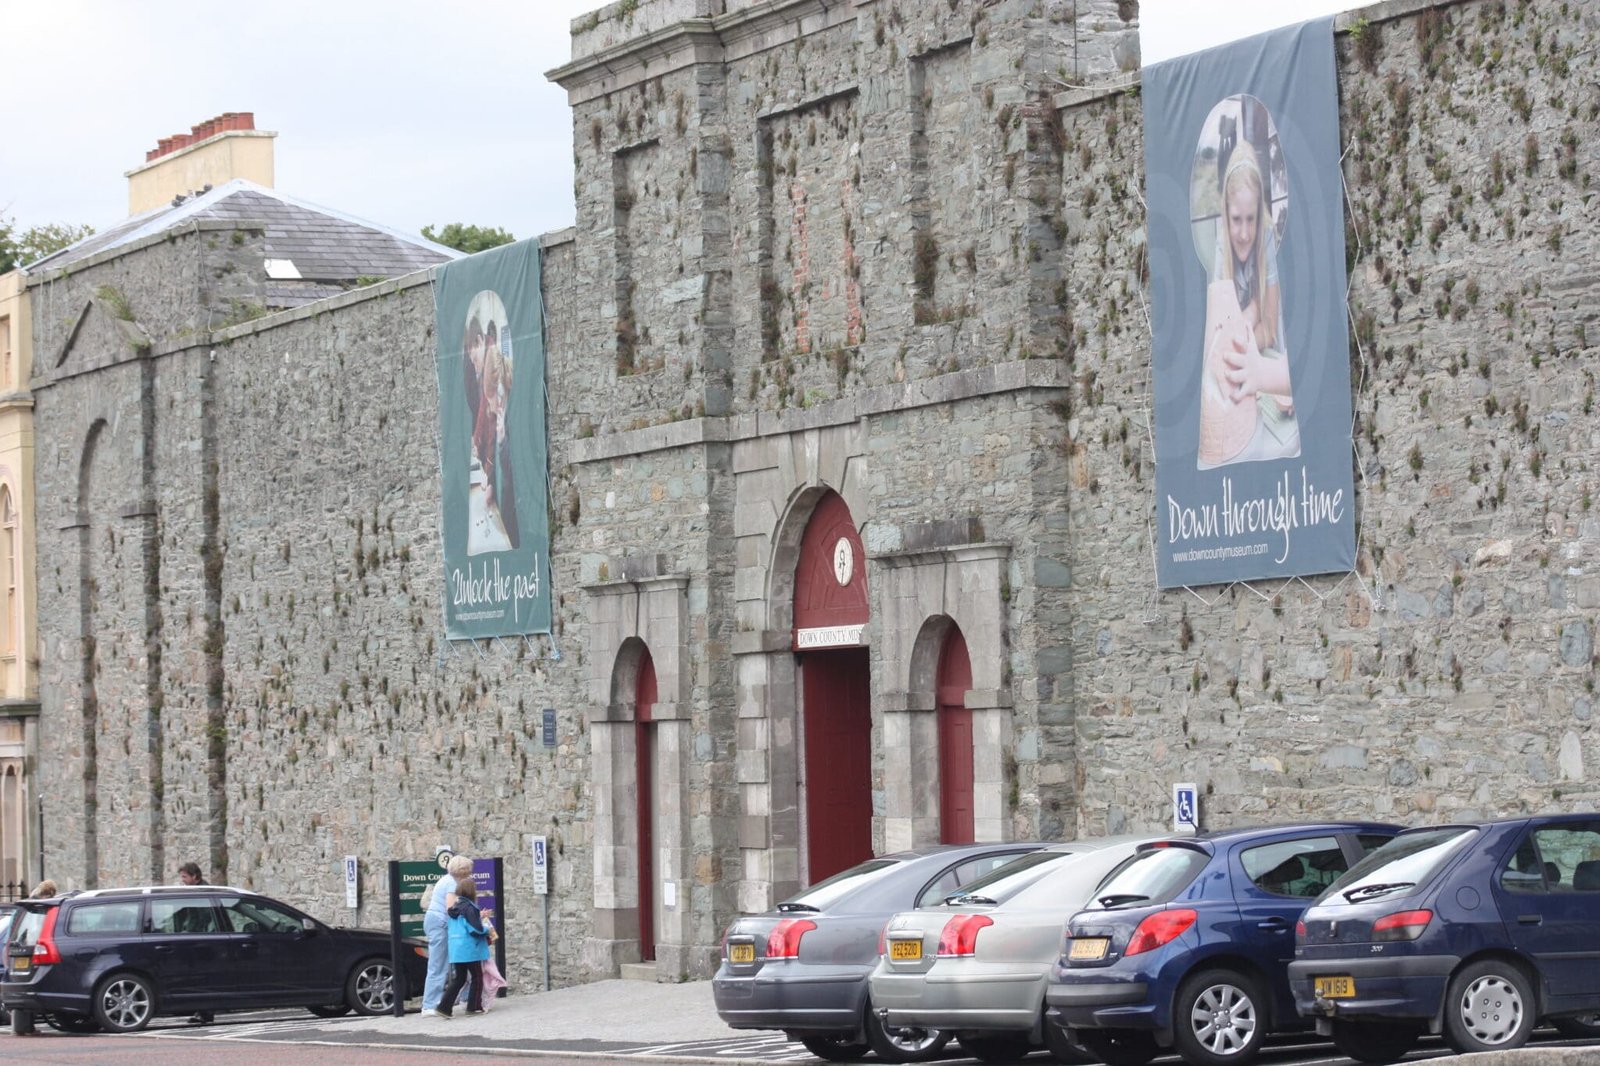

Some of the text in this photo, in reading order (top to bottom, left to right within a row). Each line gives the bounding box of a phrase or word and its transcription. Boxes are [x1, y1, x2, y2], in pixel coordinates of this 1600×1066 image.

[1167, 464, 1344, 564] Down through time
[1172, 543, 1268, 562] www.downcountymuseum.com
[452, 551, 540, 623] Unlock the past
[800, 632, 818, 645] DOWN
